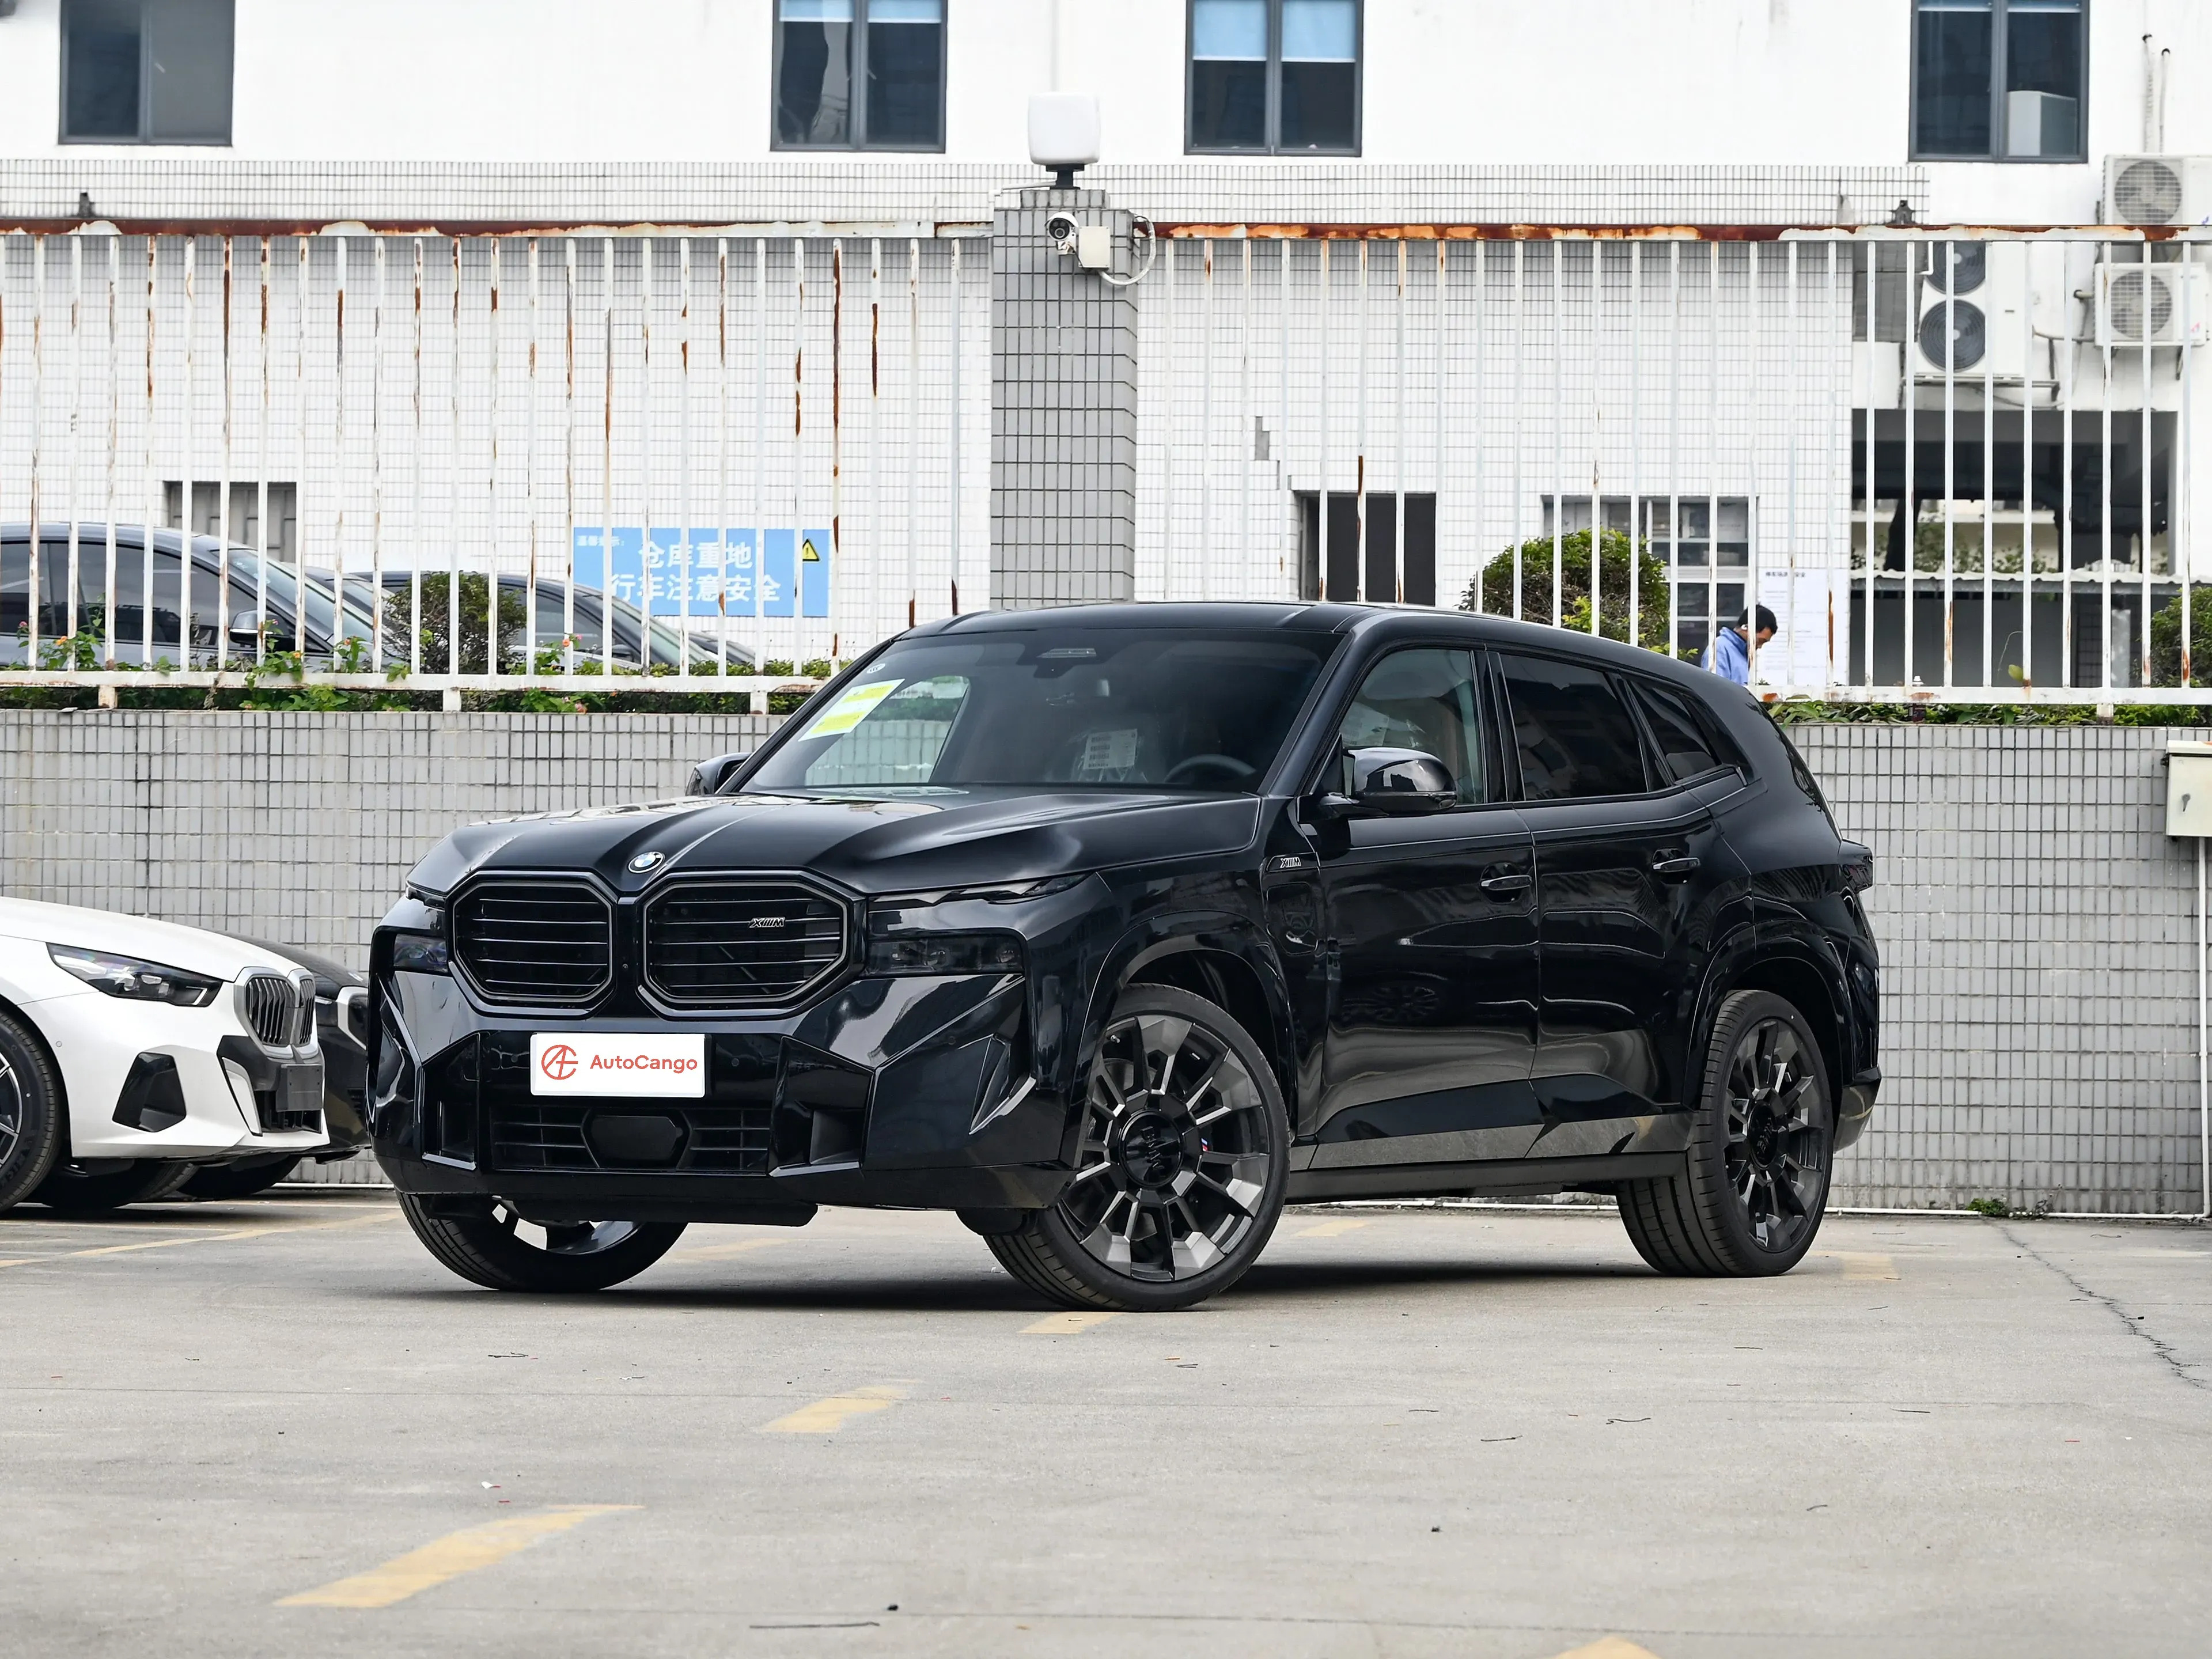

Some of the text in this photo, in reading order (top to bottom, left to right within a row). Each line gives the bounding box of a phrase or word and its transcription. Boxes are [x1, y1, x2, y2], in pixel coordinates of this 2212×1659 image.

[638, 541, 753, 569] 仓库重地
[610, 574, 781, 602] 行车注意安全
